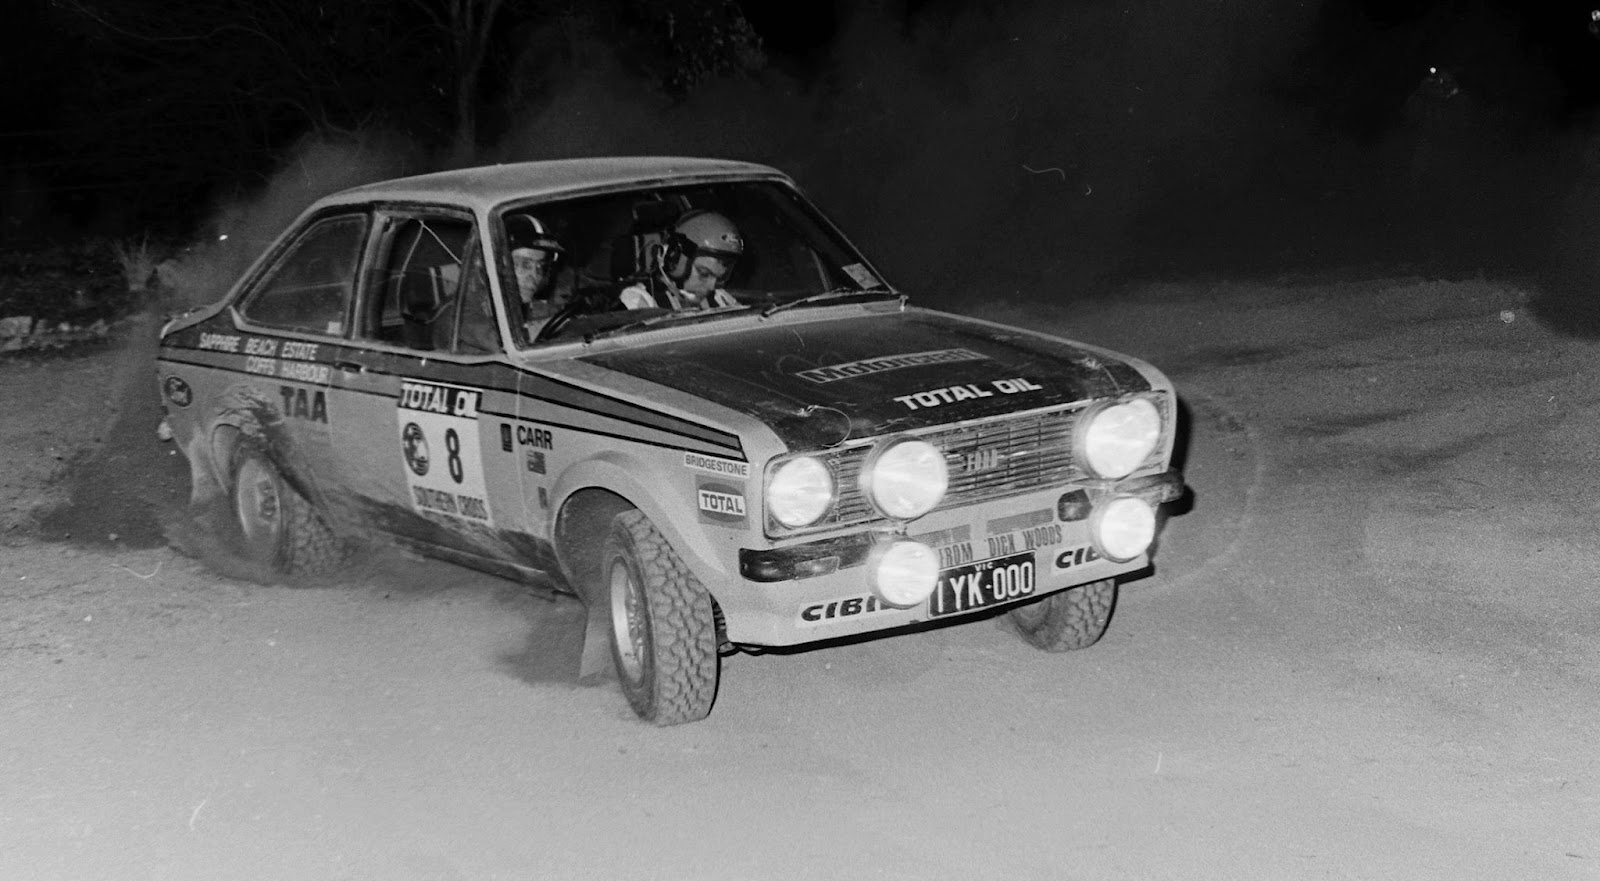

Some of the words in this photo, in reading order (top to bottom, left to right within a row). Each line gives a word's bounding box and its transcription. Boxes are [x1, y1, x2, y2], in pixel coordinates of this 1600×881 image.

[245, 338, 278, 355] BEACH
[282, 341, 319, 360] ESTATE
[280, 385, 329, 424] TAA
[401, 383, 449, 413] TOTAL
[453, 391, 478, 418] OIL
[893, 383, 994, 410] TOTAL
[991, 377, 1043, 395] OIL
[517, 424, 553, 451] CARR
[445, 427, 464, 484] 8
[685, 454, 748, 476] BRIDGESTONE
[701, 492, 743, 514] TOTAL
[938, 542, 974, 568] FROM
[1022, 524, 1063, 550] WOODS
[975, 561, 994, 572] VIC
